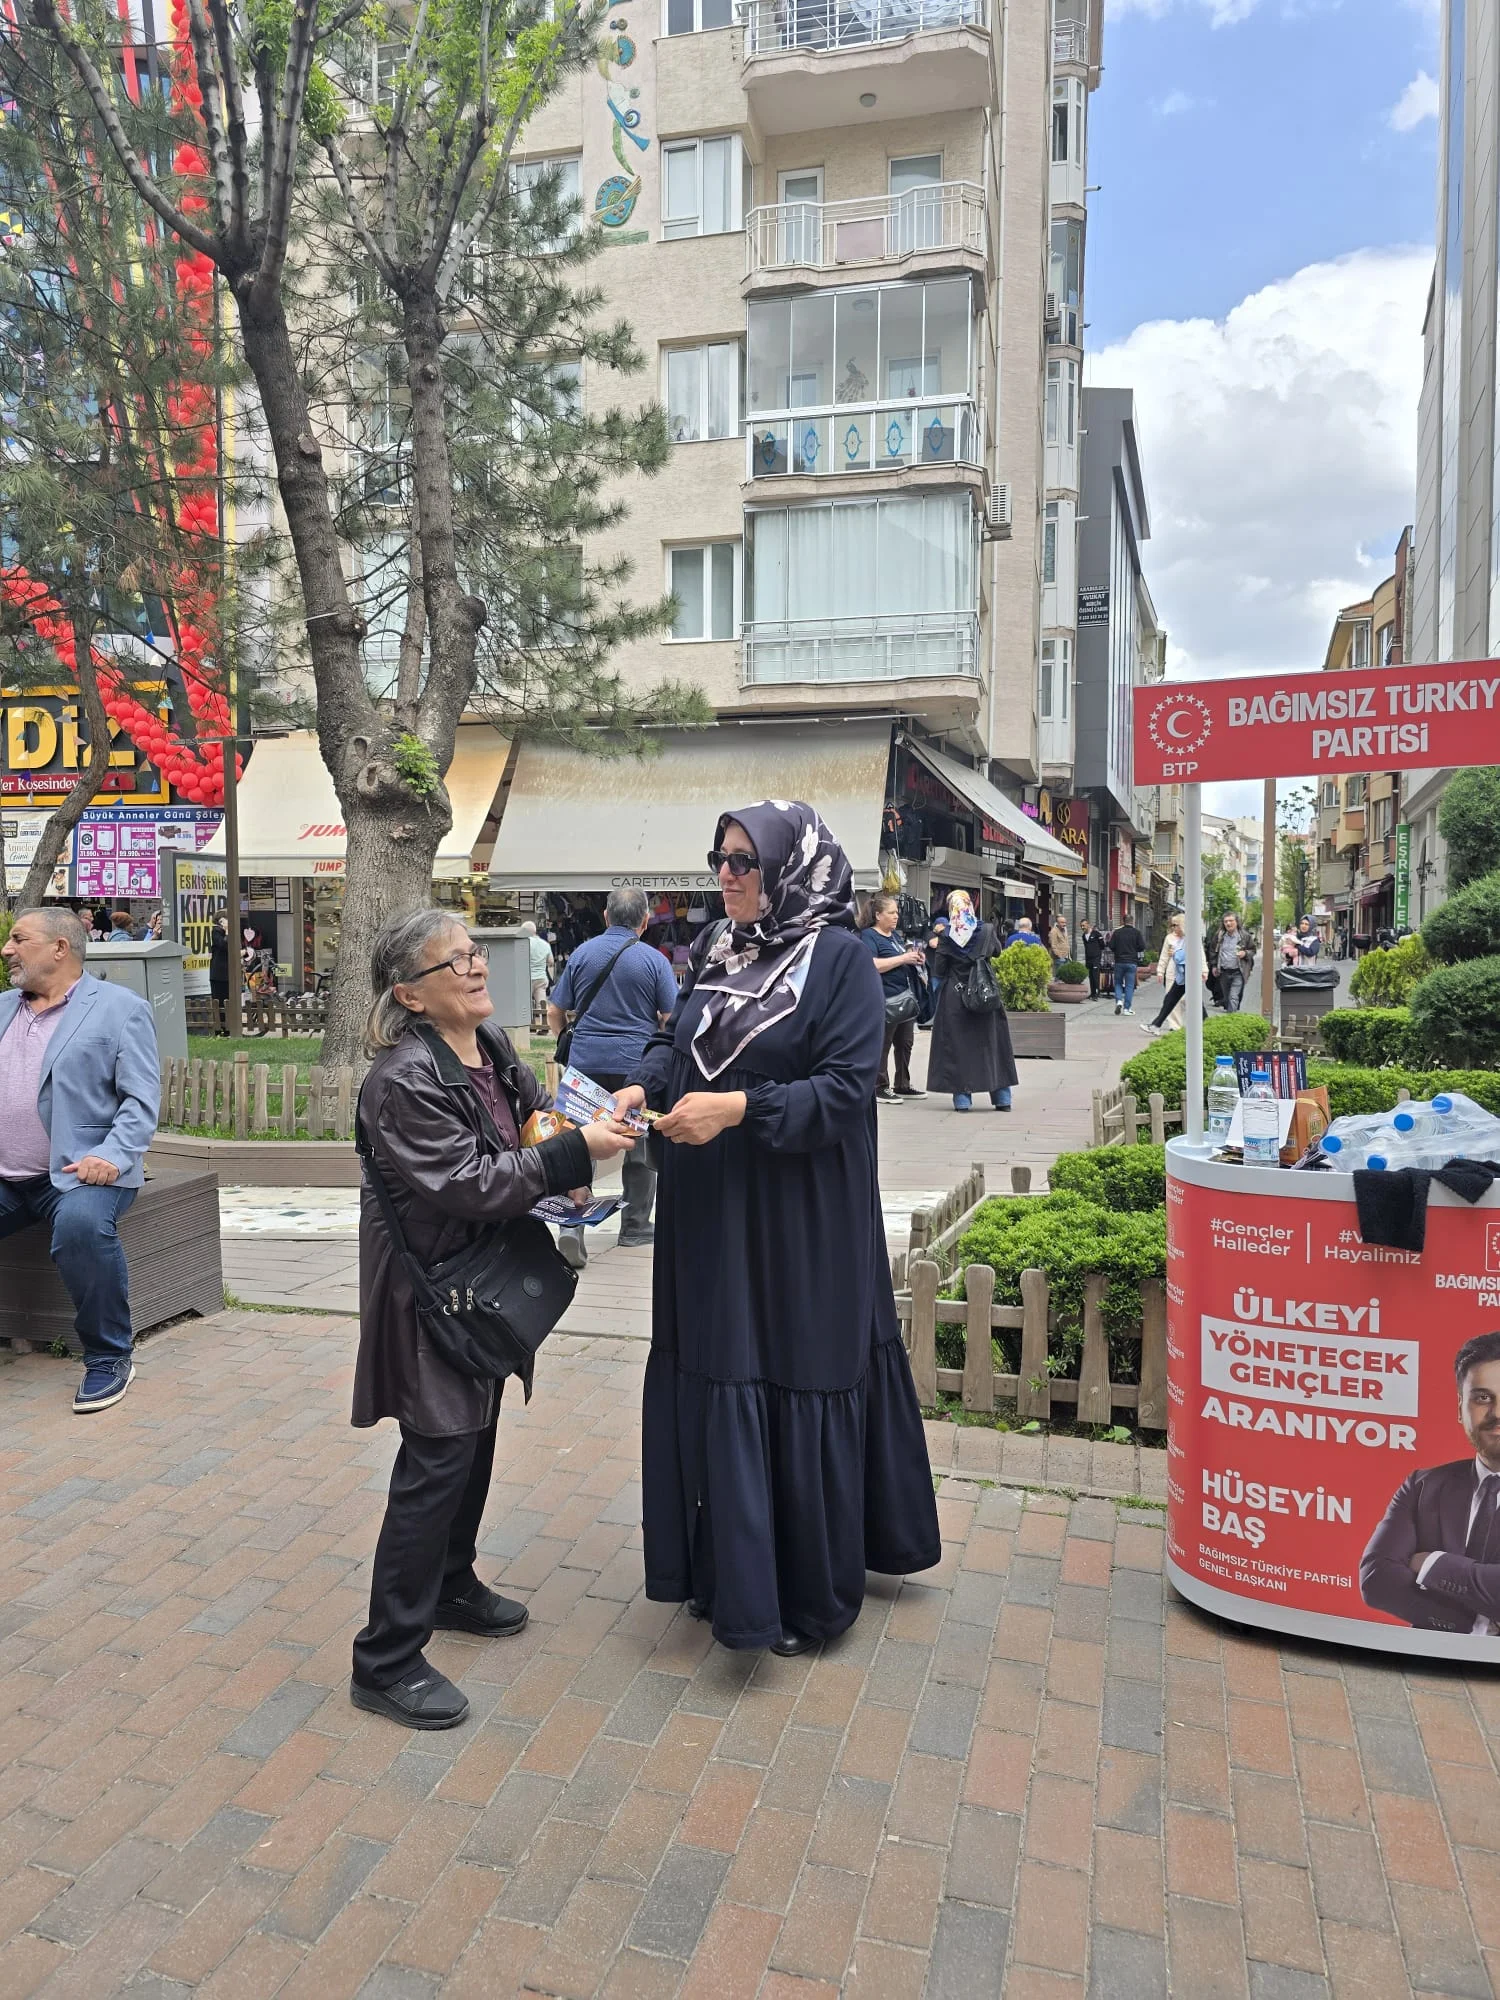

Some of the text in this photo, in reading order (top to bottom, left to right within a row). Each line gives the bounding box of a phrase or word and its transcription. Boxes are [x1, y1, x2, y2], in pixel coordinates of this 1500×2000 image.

[1229, 678, 1500, 727] BAĞIMSIZ TÜRKİY
[1312, 723, 1429, 759] PARTİSİ
[1162, 761, 1199, 777] BTP
[82, 811, 114, 821] Büyük
[118, 811, 160, 820] Anneler
[164, 811, 191, 820] Günü
[313, 861, 343, 874] JUMP
[611, 877, 690, 887] CARETTA'S
[1210, 1217, 1294, 1241] #Gençler
[1213, 1234, 1290, 1256] Halleder
[1324, 1245, 1421, 1265] Hayalimiz
[1233, 1286, 1380, 1334] ÜLKEYİ
[1478, 1292, 1500, 1307] PA
[1209, 1329, 1409, 1375] YÖNETECEK
[1229, 1362, 1383, 1400] GENÇLER
[1200, 1396, 1417, 1451] ARANIYOR
[1202, 1468, 1352, 1524] HÜSEYİN
[1202, 1502, 1266, 1549] BAŞ
[1199, 1543, 1249, 1568] BAĞIMSIZ
[1250, 1560, 1302, 1580] TÜRKİYE
[1304, 1571, 1352, 1588] PARTİSİ
[1199, 1557, 1287, 1592] GENEL BAŞKANI
